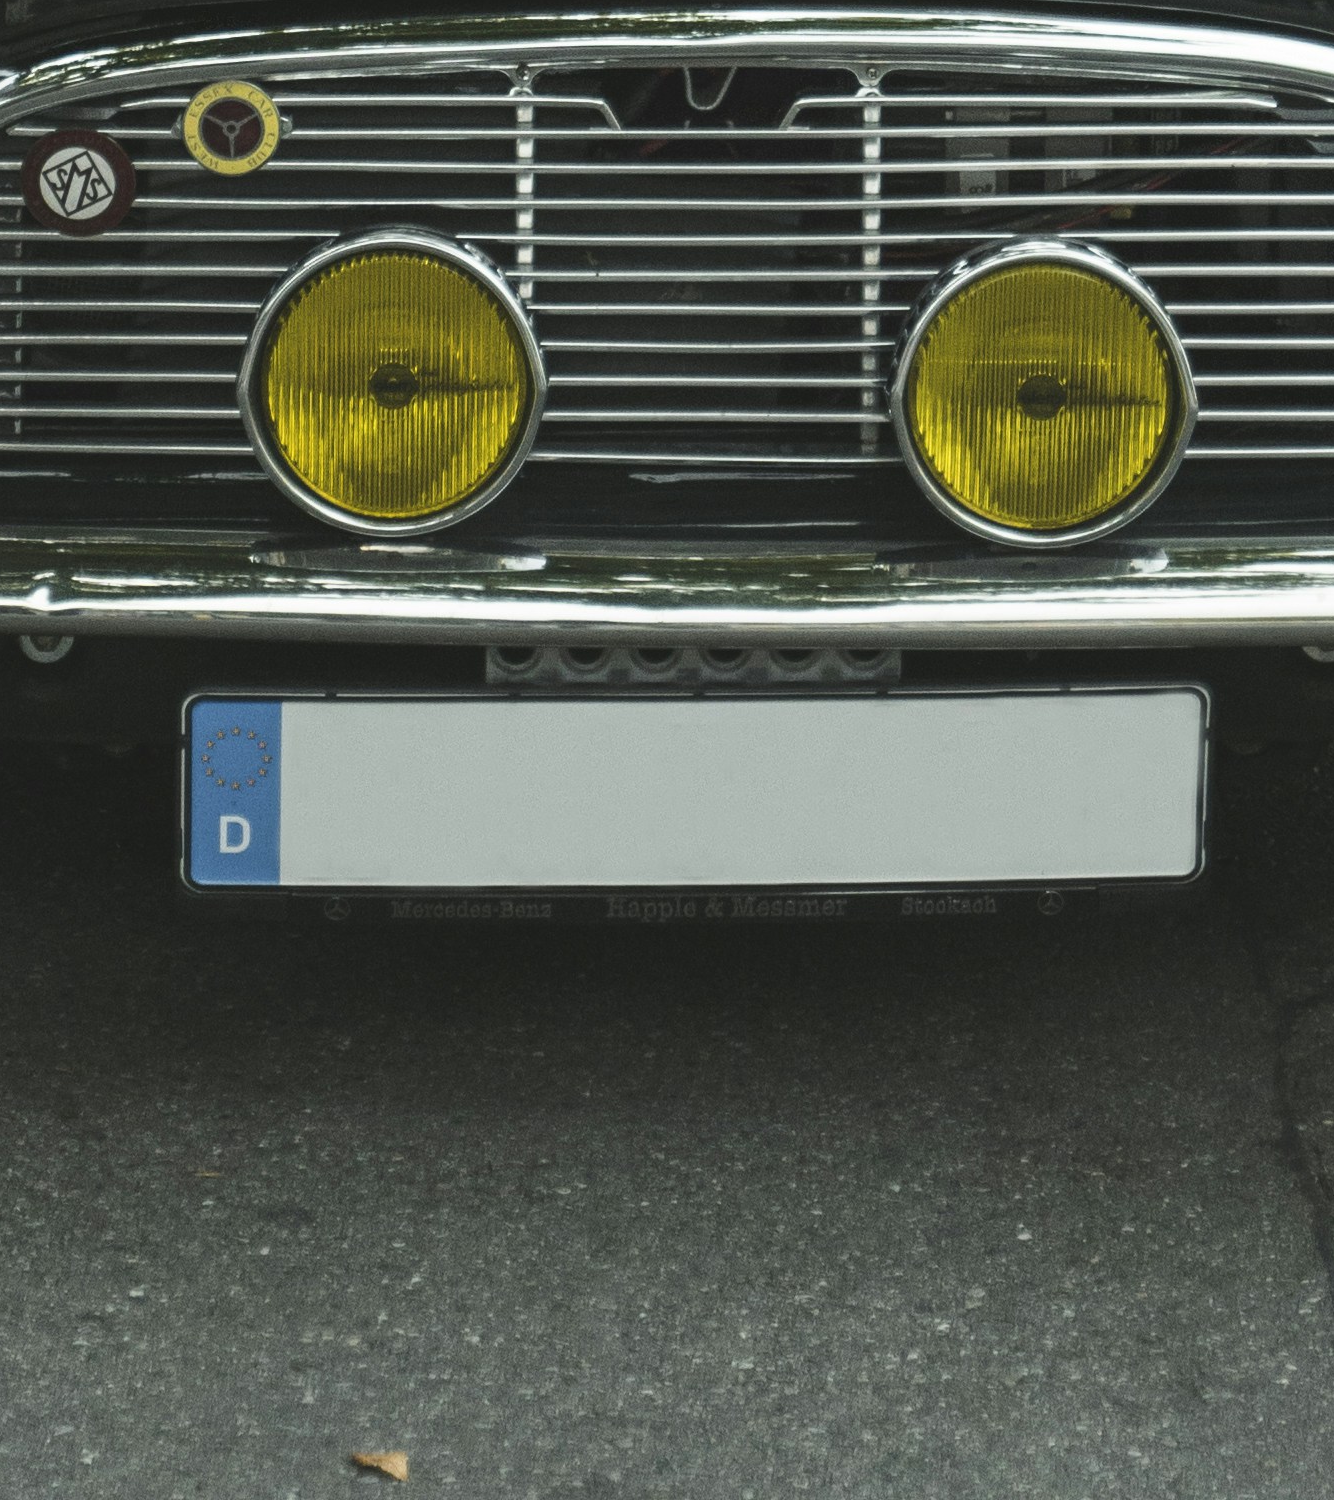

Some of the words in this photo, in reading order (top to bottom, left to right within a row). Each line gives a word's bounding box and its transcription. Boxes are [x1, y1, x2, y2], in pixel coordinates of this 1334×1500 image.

[188, 82, 234, 118] ESSEX
[247, 90, 275, 119] CAR
[188, 135, 219, 169] WEST
[247, 131, 275, 169] CLUB
[219, 815, 251, 854] D
[390, 899, 552, 919] Mercedes-Benz
[704, 896, 724, 918] &
[730, 894, 848, 918] Messmer
[901, 894, 997, 916] Stockach
